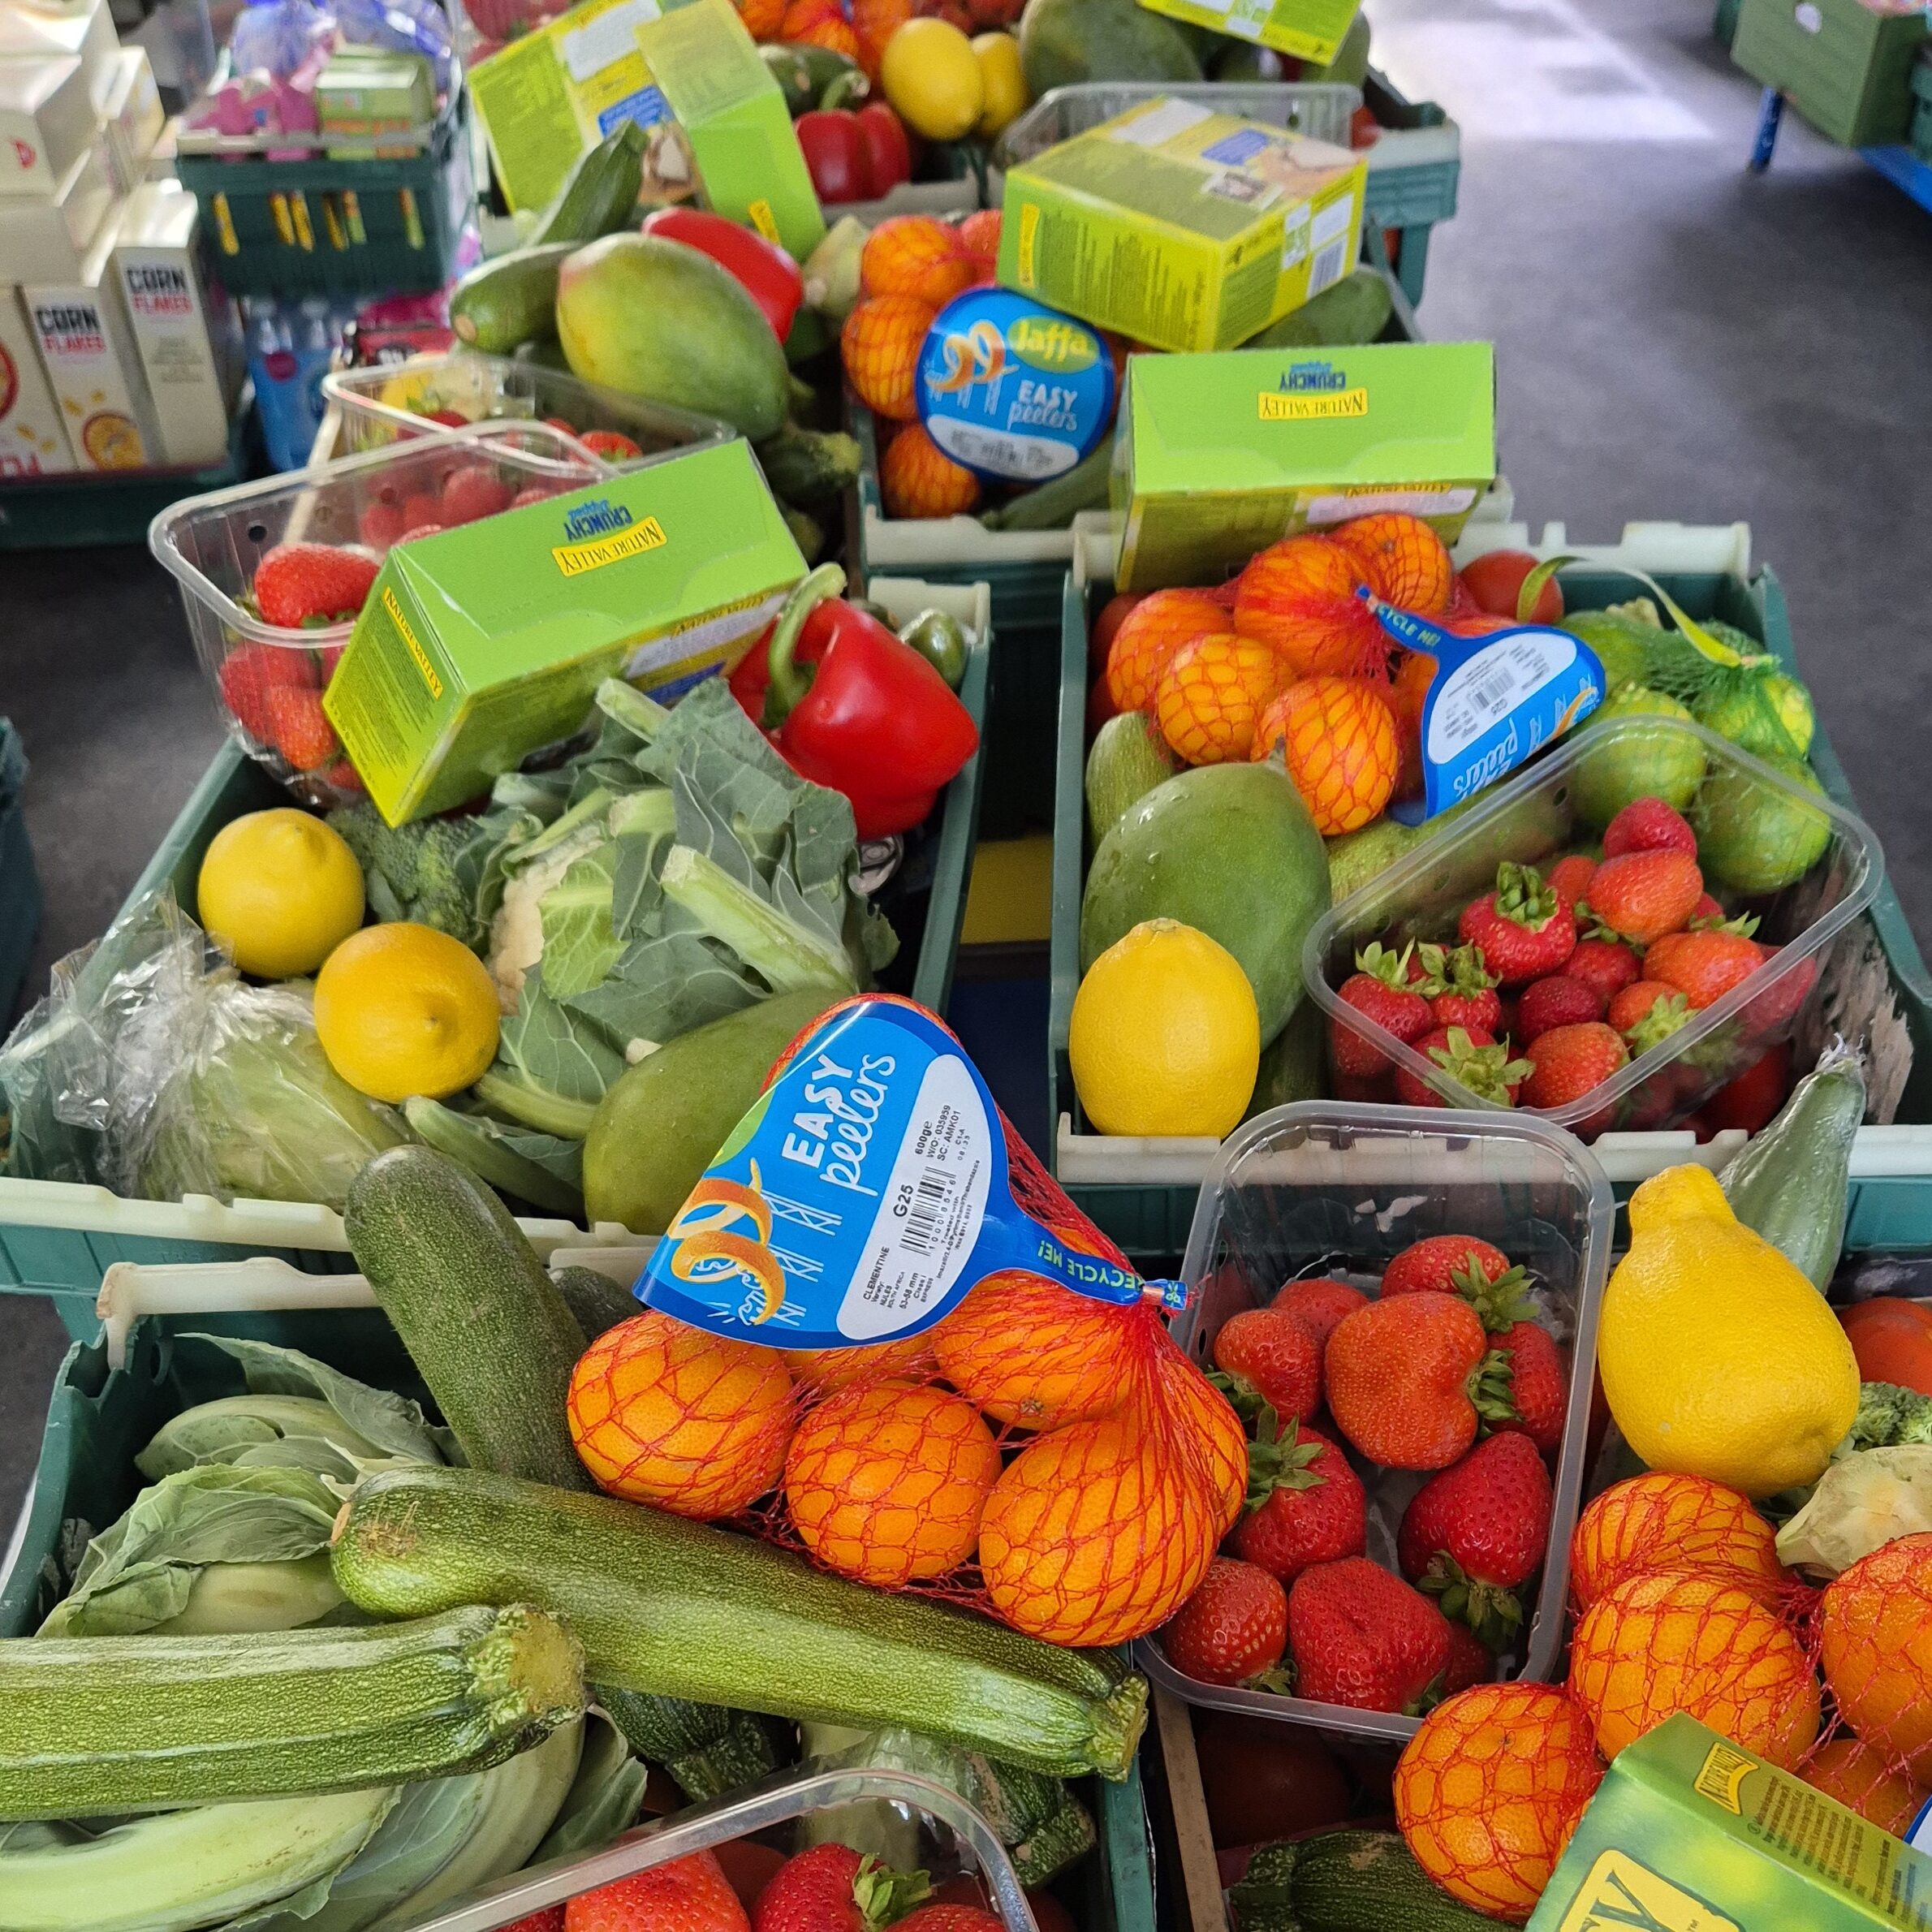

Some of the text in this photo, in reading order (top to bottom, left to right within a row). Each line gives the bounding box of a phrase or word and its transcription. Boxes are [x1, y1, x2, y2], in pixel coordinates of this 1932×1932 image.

[126, 268, 186, 292] CORN
[37, 307, 101, 334] CORN
[1015, 320, 1090, 362] Jaffa
[1019, 379, 1078, 412] EASY
[1279, 373, 1346, 390] CRUNCHY
[1007, 400, 1078, 433] peelers
[1263, 393, 1363, 418] NATURE VALLEY
[563, 506, 633, 542] CRUNCHY
[559, 522, 662, 574] NATURE VALLEY
[386, 591, 441, 692] NATURE VALLEY
[1453, 717, 1519, 793] peelers
[781, 1054, 853, 1169] EASY
[819, 1054, 896, 1197] peelers
[927, 1105, 951, 1158] W/O: 035959
[938, 1110, 961, 1161] SC: AMK01
[893, 1184, 914, 1218] G25
[1037, 1240, 1063, 1268] ME!
[863, 1246, 890, 1300] CLEMENTINE
[899, 1272, 918, 1309] 53-58 mm
[913, 1279, 925, 1299] Class
[879, 1285, 892, 1306] NULES
